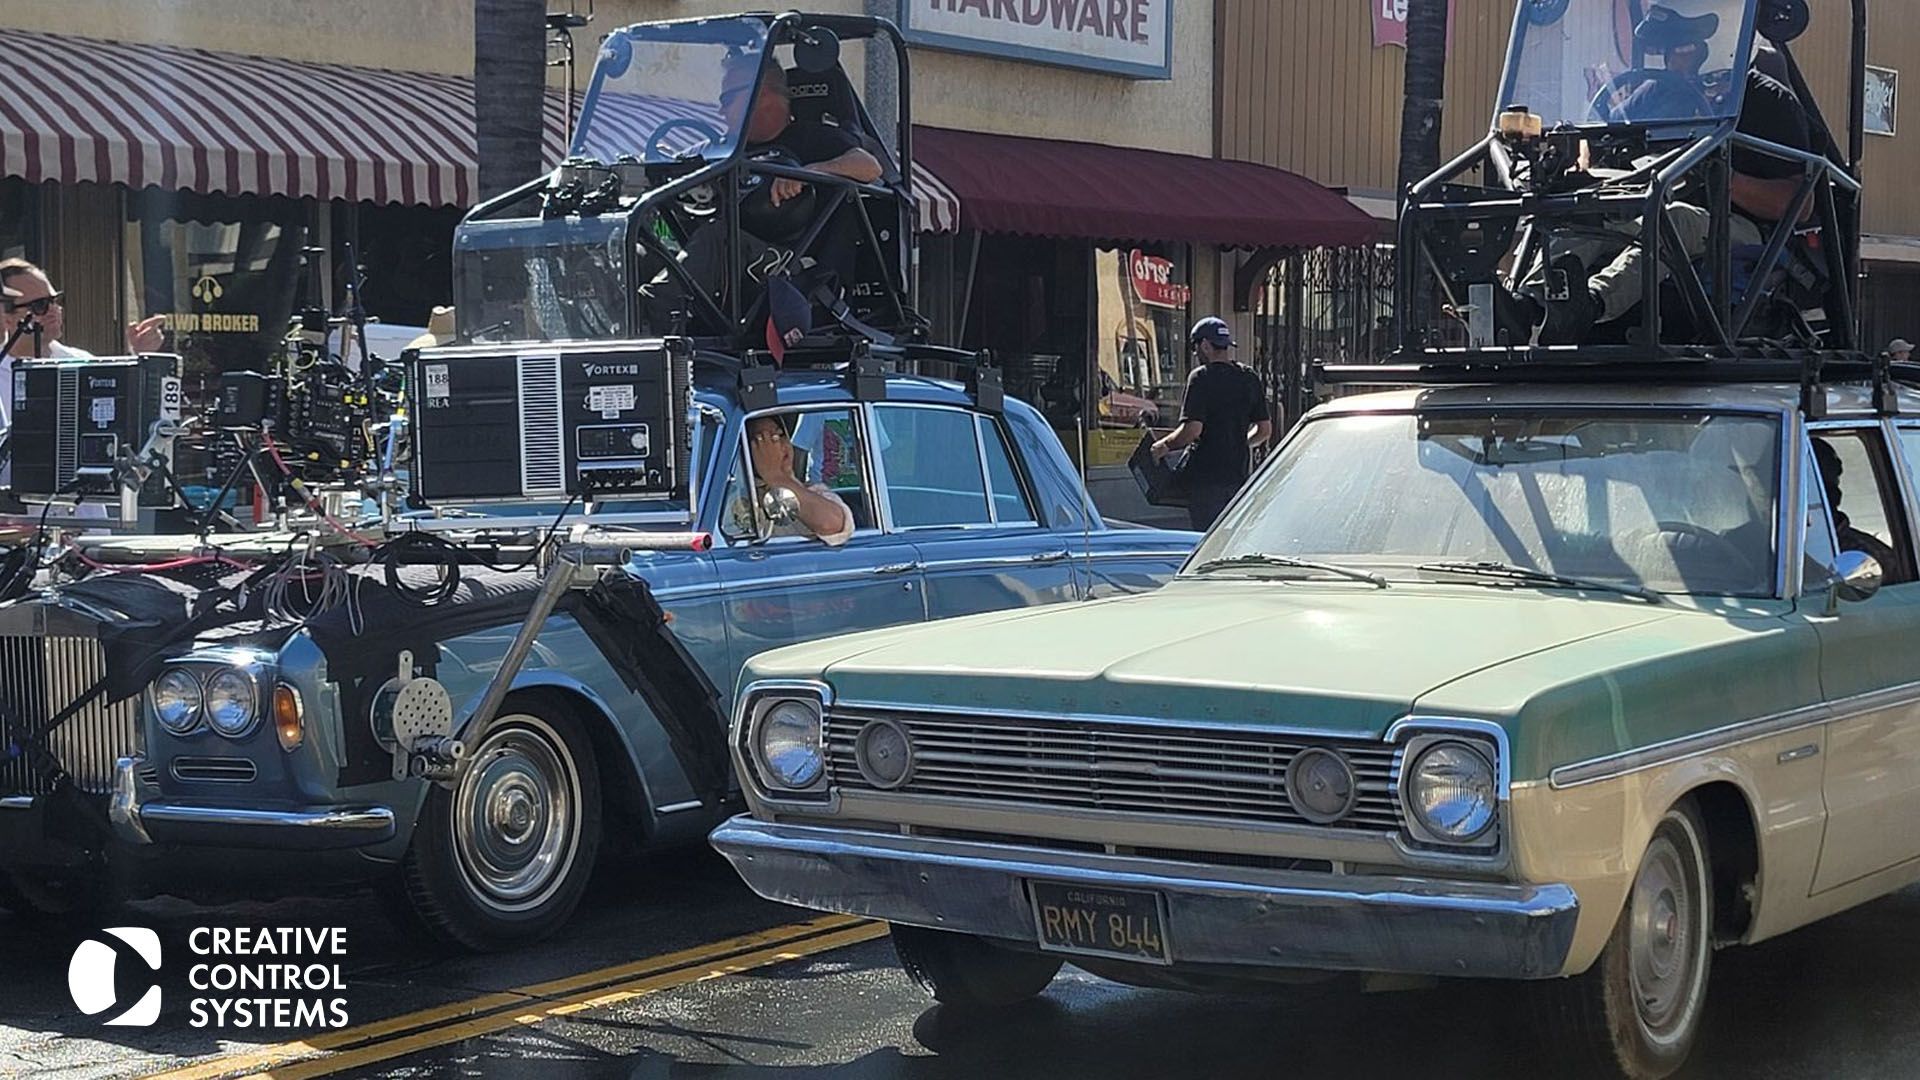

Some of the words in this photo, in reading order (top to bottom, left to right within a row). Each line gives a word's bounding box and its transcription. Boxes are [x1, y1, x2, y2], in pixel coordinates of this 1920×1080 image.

[202, 313, 259, 331] BROKER
[428, 374, 448, 384] 188
[164, 381, 180, 414] 189
[1043, 905, 1097, 943] RMY
[1109, 913, 1160, 952] 844
